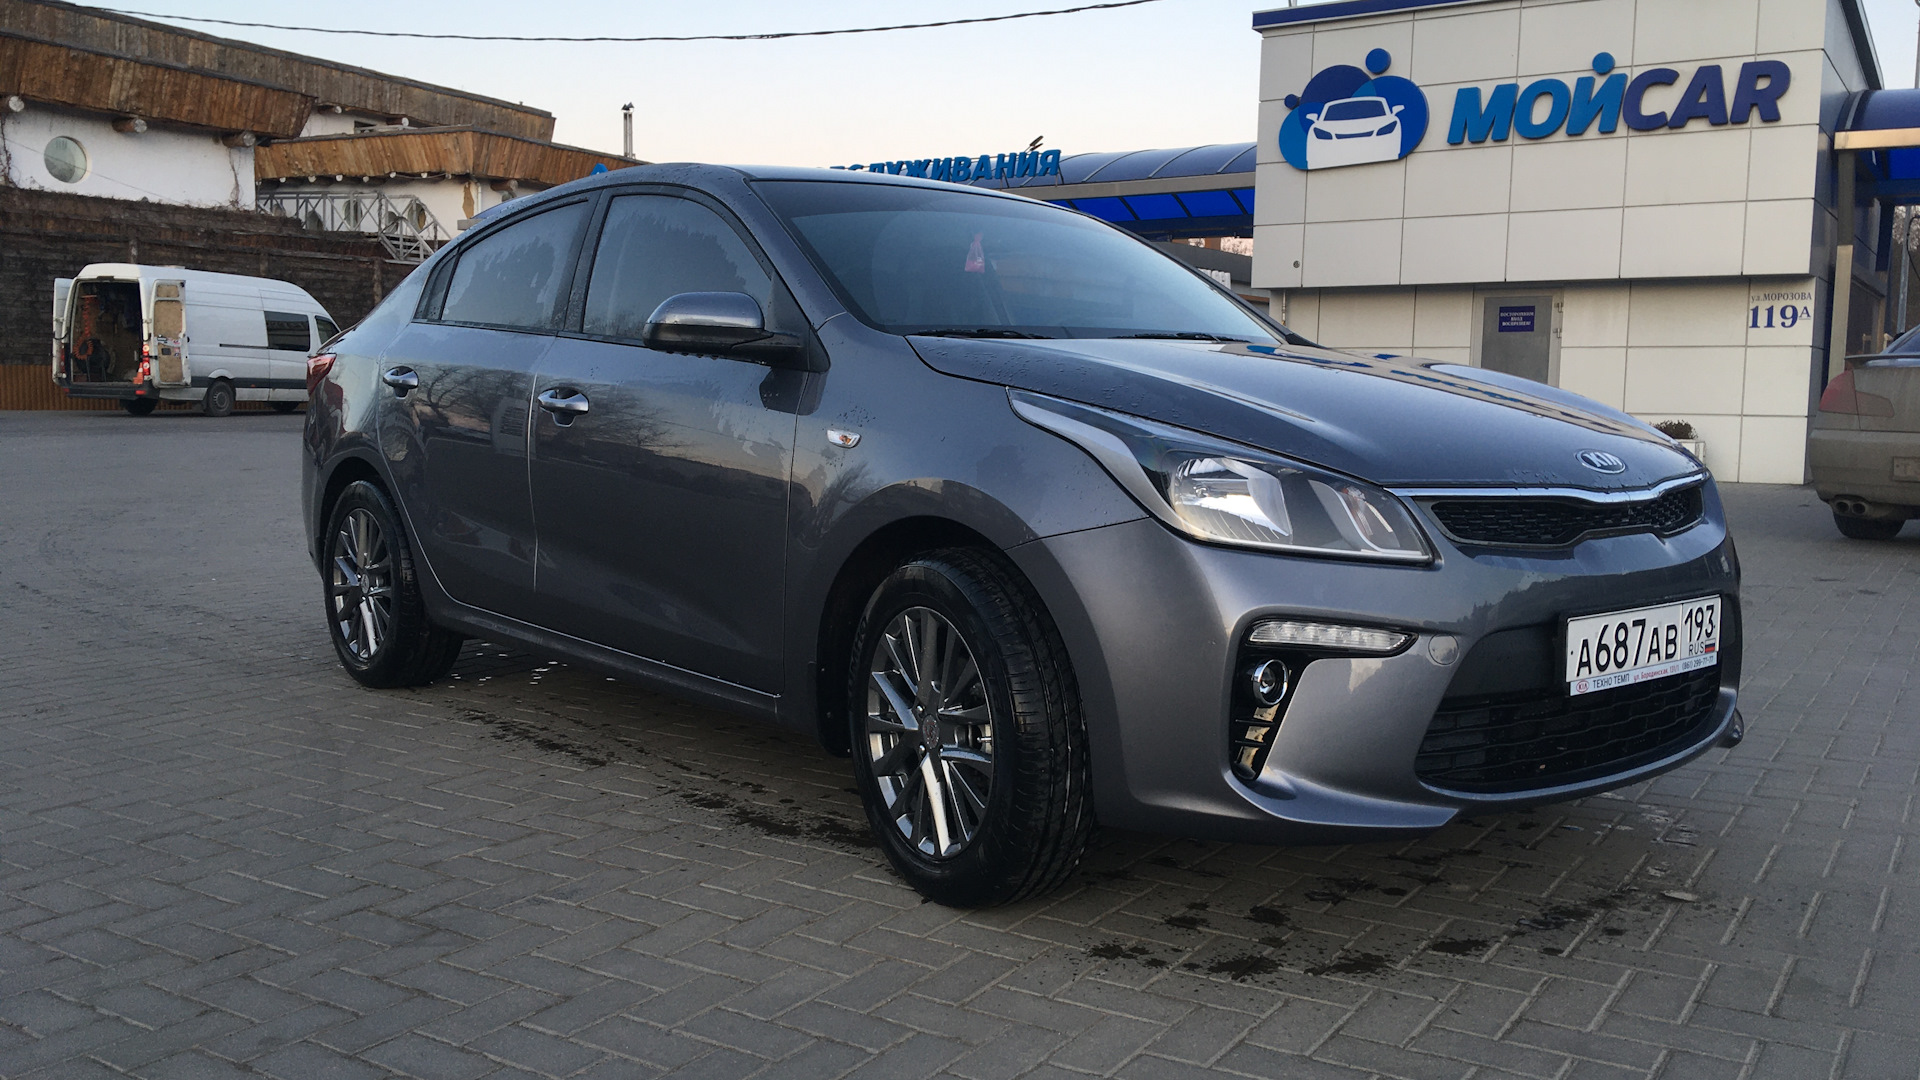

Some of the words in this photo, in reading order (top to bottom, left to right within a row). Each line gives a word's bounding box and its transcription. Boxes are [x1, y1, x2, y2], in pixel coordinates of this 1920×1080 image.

[1580, 450, 1624, 470] KIA
[1576, 618, 1678, 677] А687АВ
[1684, 604, 1715, 642] 193
[1688, 641, 1705, 655] RUS
[1593, 677, 1612, 689] ТЕХНО
[1614, 673, 1630, 685] ТЕМП
